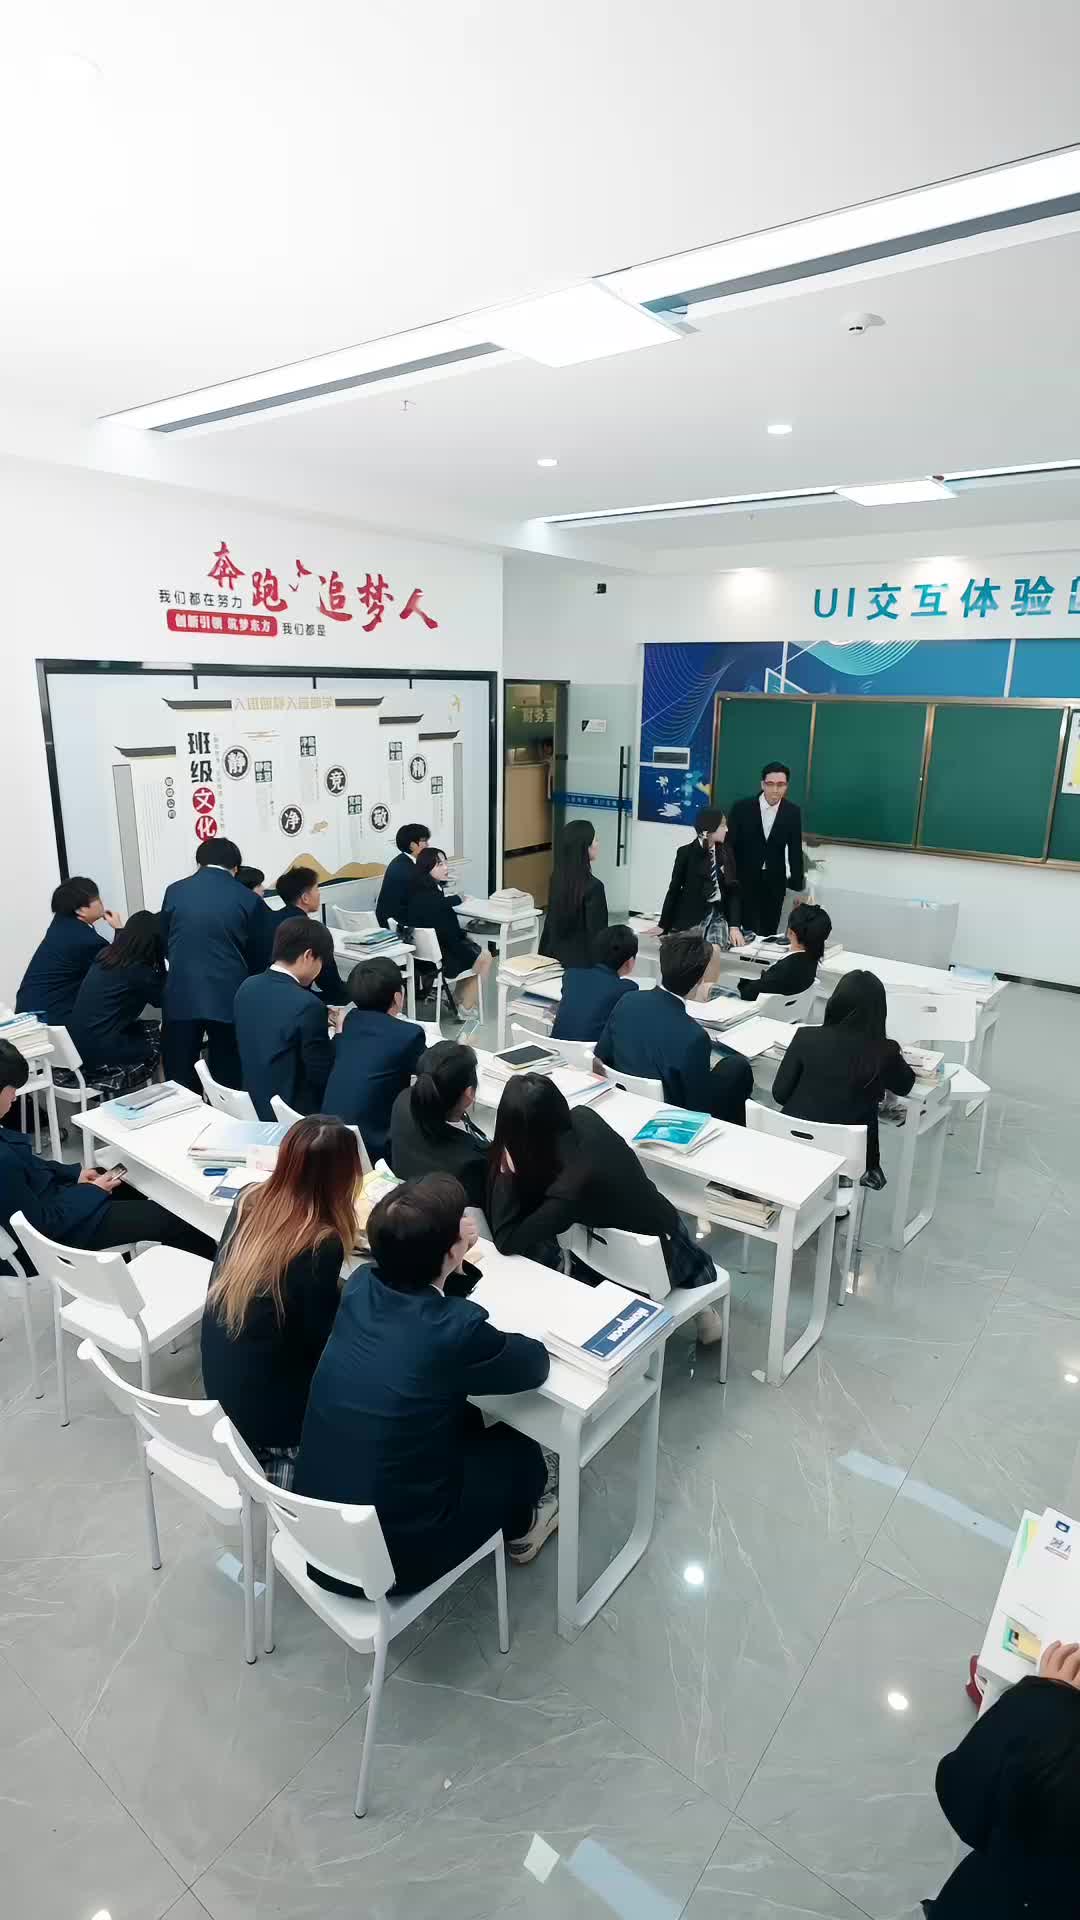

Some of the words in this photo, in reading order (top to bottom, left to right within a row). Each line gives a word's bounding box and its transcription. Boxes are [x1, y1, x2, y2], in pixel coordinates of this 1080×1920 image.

[158, 589, 243, 609] 我们都在努力
[207, 541, 288, 613] 奔跑
[317, 570, 439, 633] 追梦人
[814, 575, 1080, 620] UI交互体验
[281, 622, 327, 637] 我们都是
[187, 731, 217, 840] 班级文化
[284, 810, 302, 831] 净
